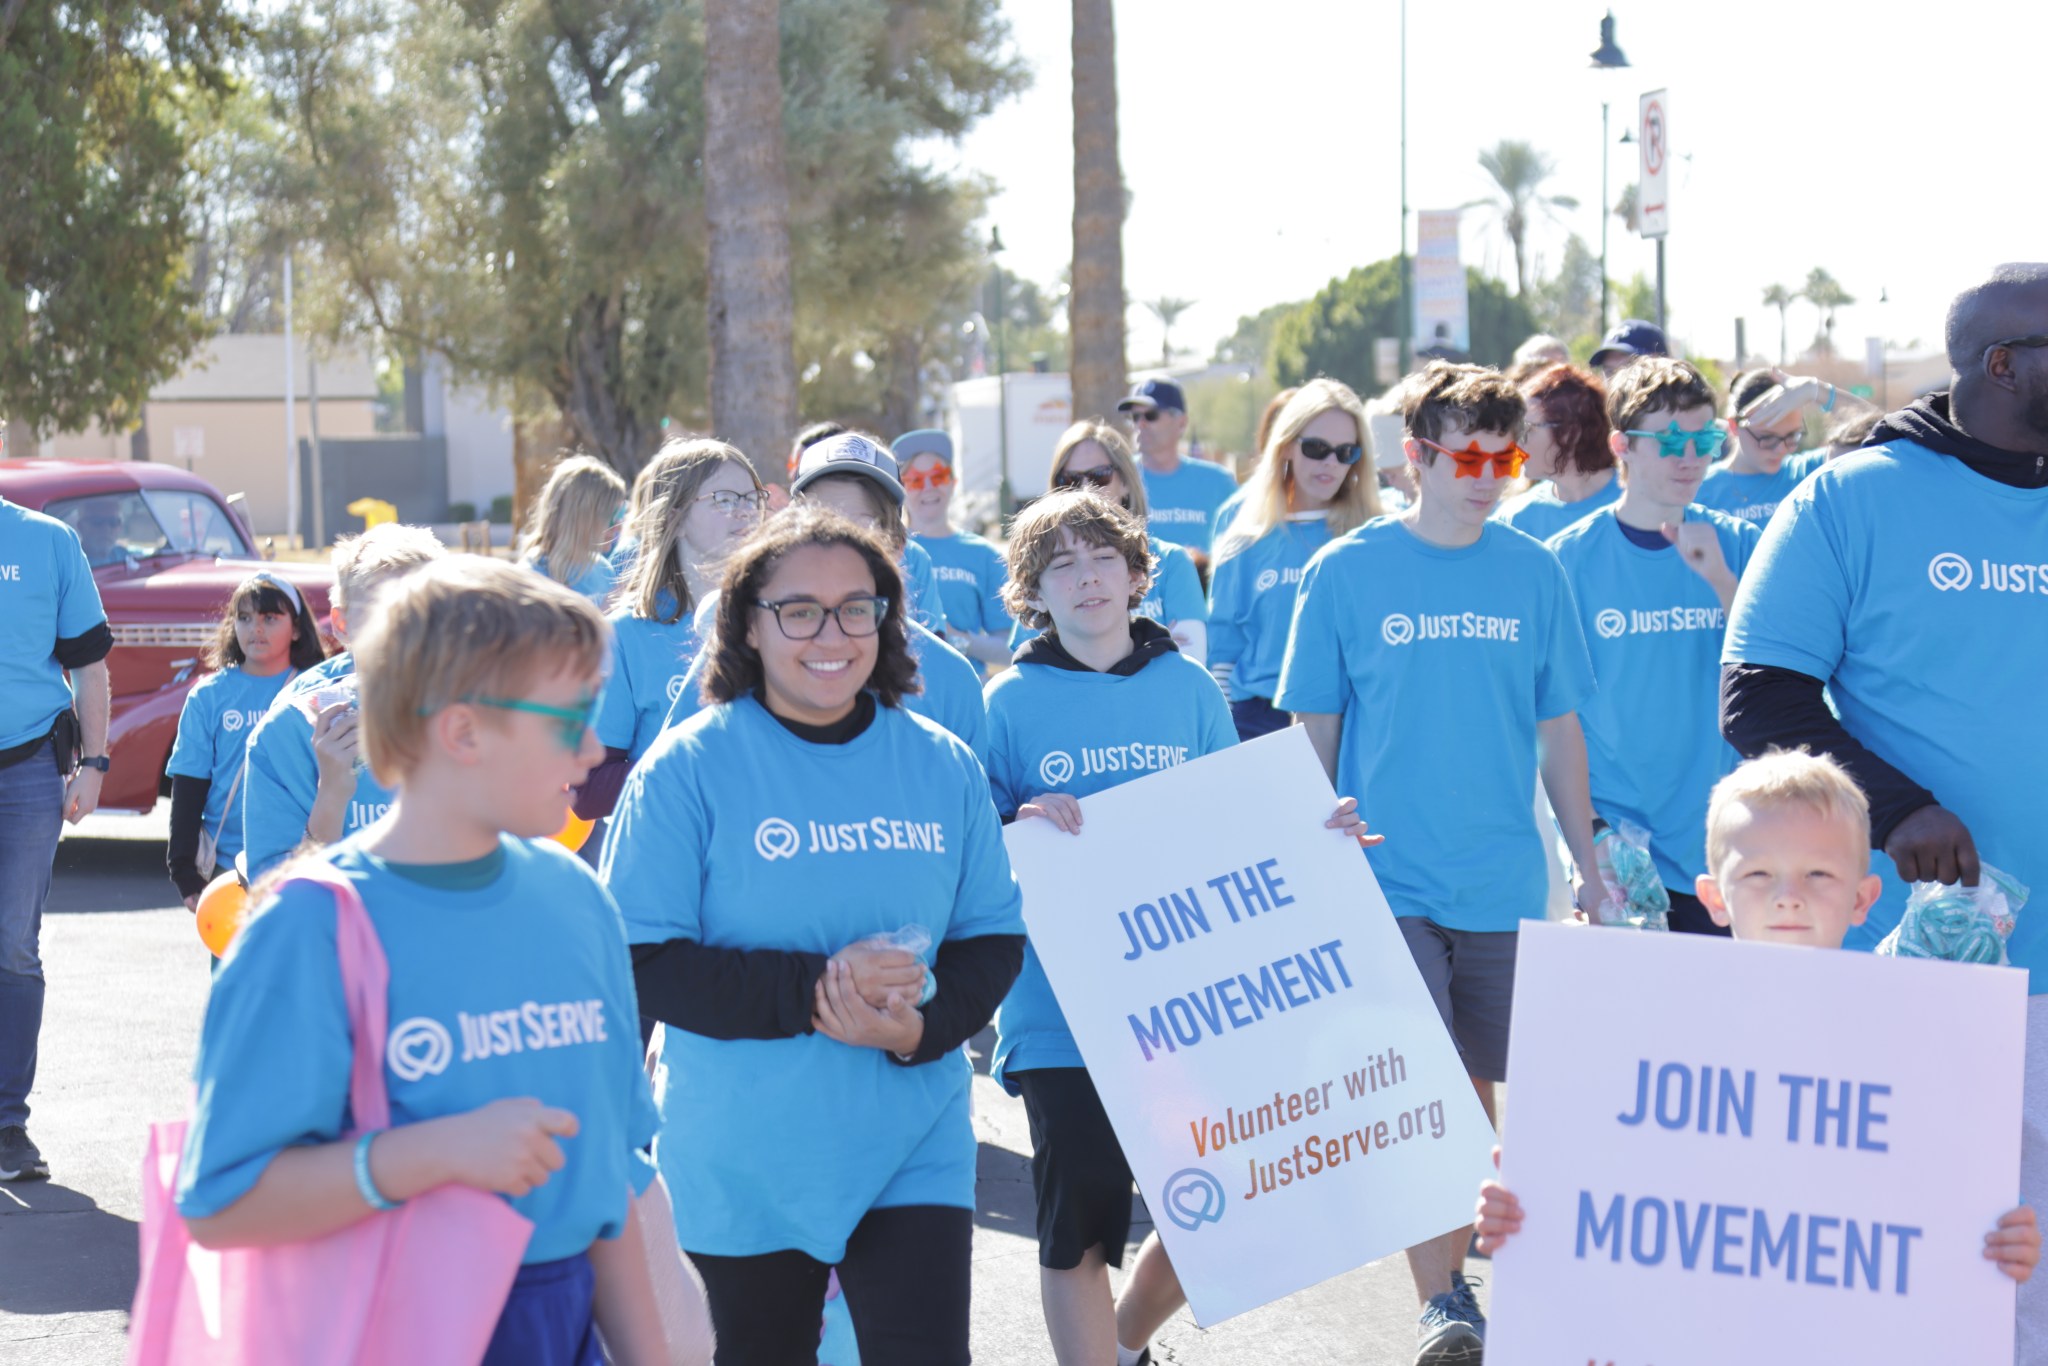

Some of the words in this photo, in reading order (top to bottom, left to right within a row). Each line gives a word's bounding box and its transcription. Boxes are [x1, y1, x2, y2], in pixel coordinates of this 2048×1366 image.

[0, 564, 20, 581] VE
[1418, 612, 1520, 642] JUSTSERVE
[246, 709, 267, 727] JU
[348, 800, 393, 829] JUS
[808, 816, 946, 854] JUSTSERVE
[1118, 886, 1211, 961] JOIN
[1207, 858, 1295, 924] THE
[457, 1000, 608, 1063] JUSTSERVE
[1126, 939, 1354, 1062] MOVEMENT
[1190, 1080, 1333, 1158] Volunteer
[1343, 1047, 1408, 1101] with
[1616, 1059, 1756, 1138] JOIN
[1778, 1073, 1892, 1152] THE
[1243, 1098, 1447, 1200] JustServe.org
[1574, 1190, 1923, 1295] MOVEMENT
